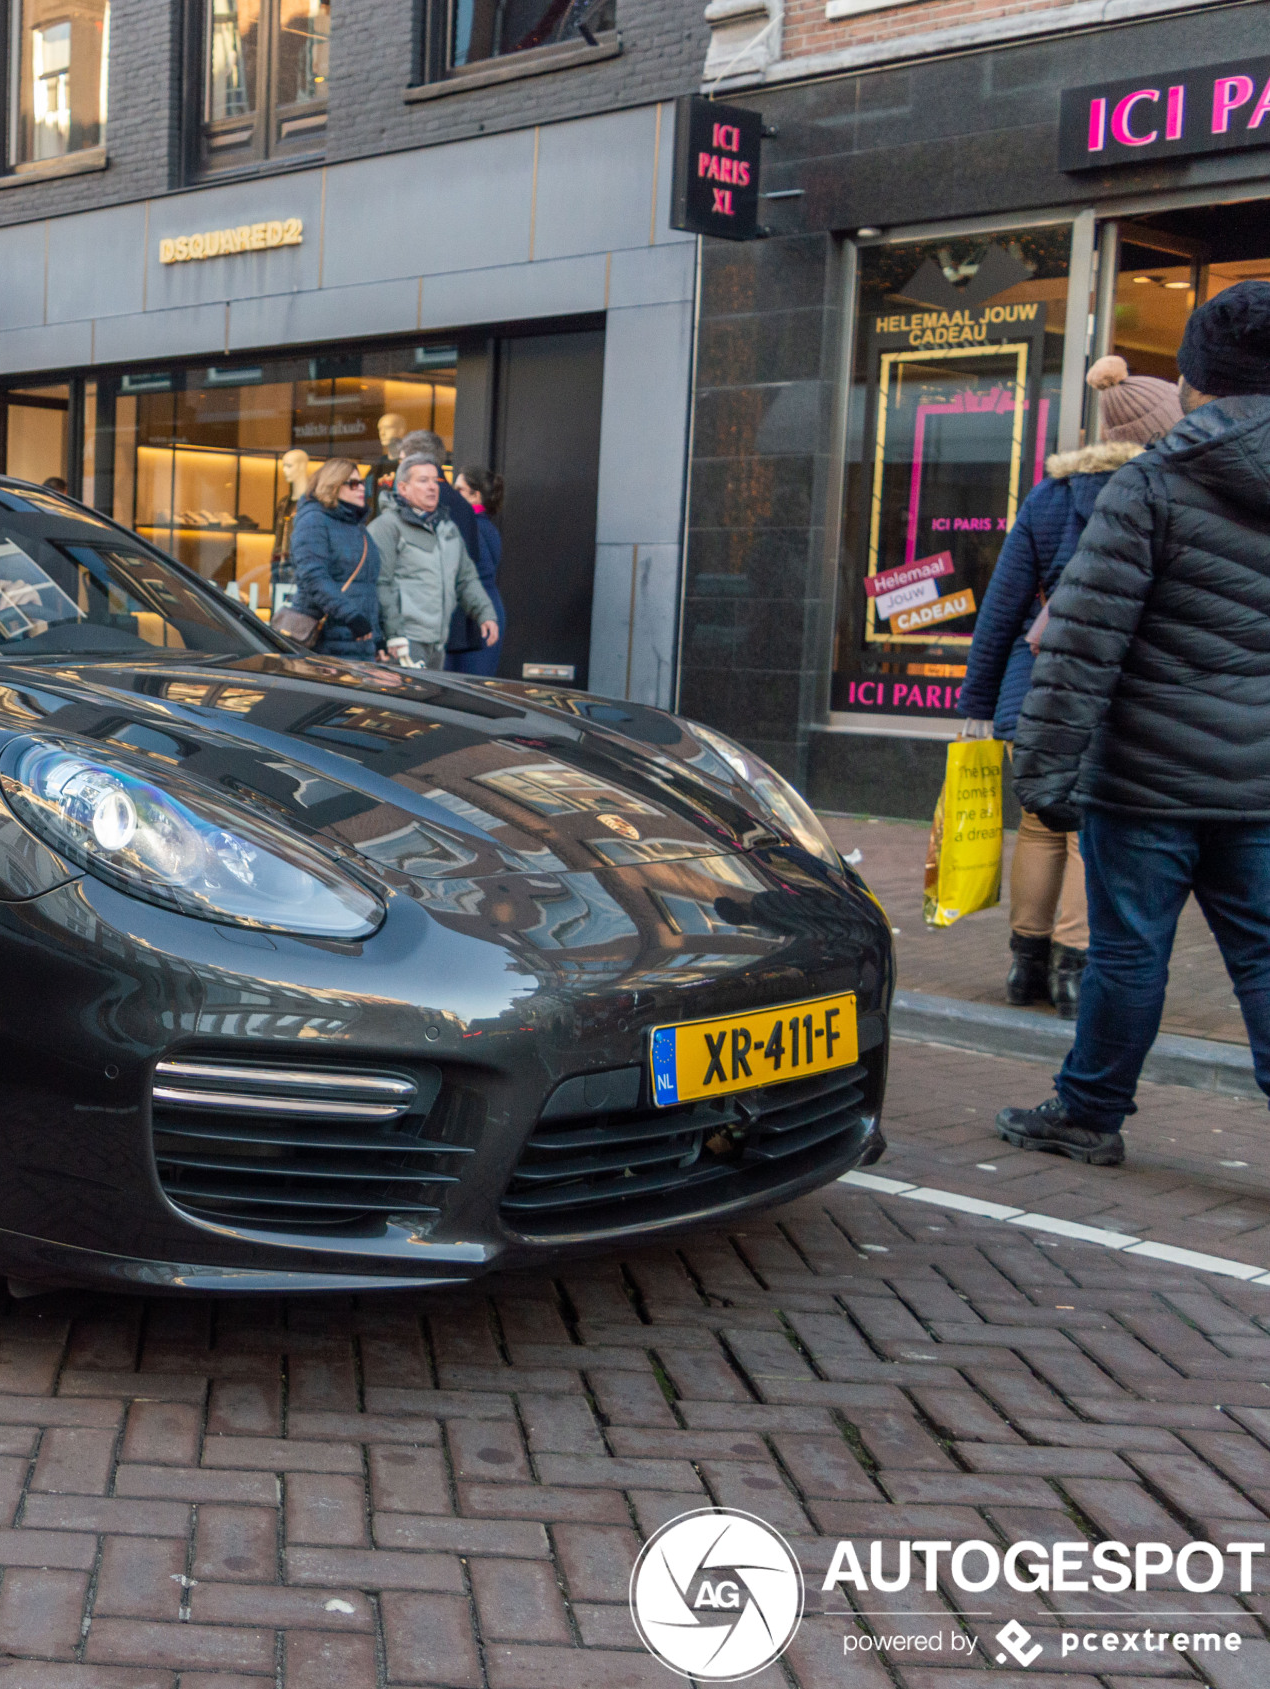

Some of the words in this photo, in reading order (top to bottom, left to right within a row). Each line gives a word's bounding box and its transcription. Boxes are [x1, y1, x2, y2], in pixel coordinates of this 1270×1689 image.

[1088, 85, 1185, 152] ICI
[712, 123, 740, 152] ICI
[697, 152, 750, 186] PARIS
[712, 188, 735, 216] XL
[159, 218, 303, 264] DSQUARED2
[876, 310, 975, 332] HELEMAAL
[979, 303, 1038, 324] JOUW
[909, 325, 987, 345] CADEAU
[932, 518, 951, 531] ICI
[953, 518, 992, 531] PARIS
[996, 518, 1007, 530] X
[874, 557, 945, 593] Helemaal
[887, 585, 926, 608] Jouw
[898, 597, 967, 629] CADEAU
[848, 681, 885, 705] ICI
[702, 1008, 840, 1086] XR-411-F
[657, 1074, 673, 1091] NL
